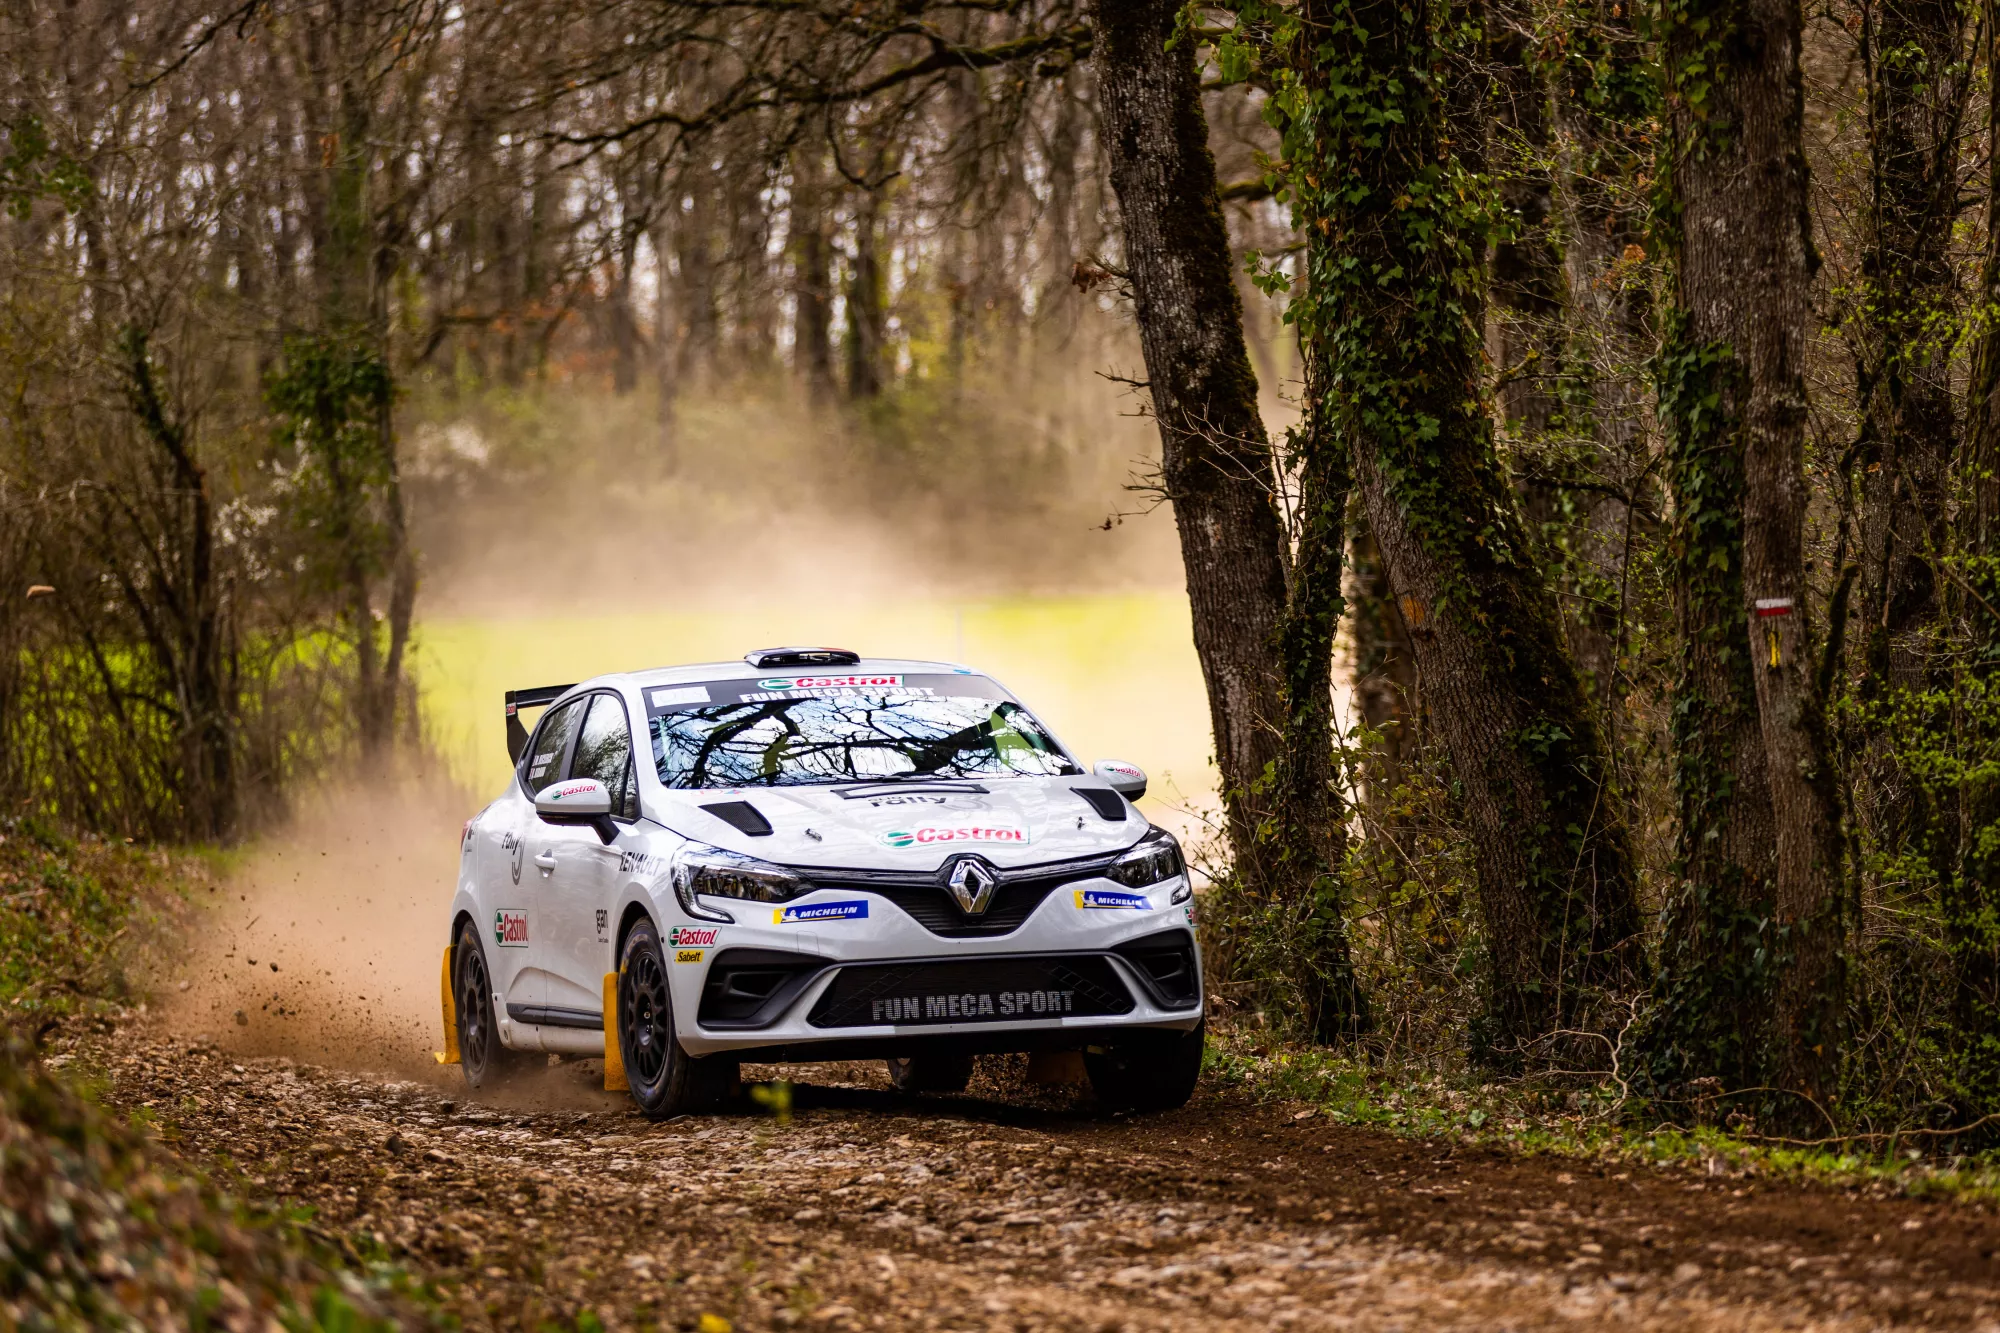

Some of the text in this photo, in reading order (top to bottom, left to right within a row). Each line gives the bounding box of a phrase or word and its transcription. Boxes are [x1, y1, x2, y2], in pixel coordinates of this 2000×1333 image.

[796, 676, 899, 688] Castrol
[740, 687, 935, 703] FUN MECA SPORT
[562, 785, 597, 797] Castrol
[916, 827, 1025, 843] Castrol
[1098, 897, 1142, 906] MICHELIN
[800, 906, 857, 918] MICHELIN
[504, 913, 528, 942] Castrol
[679, 928, 717, 945] Castrol
[678, 951, 701, 962] Sabelt
[872, 990, 1074, 1021] FUN MECA SPORT
